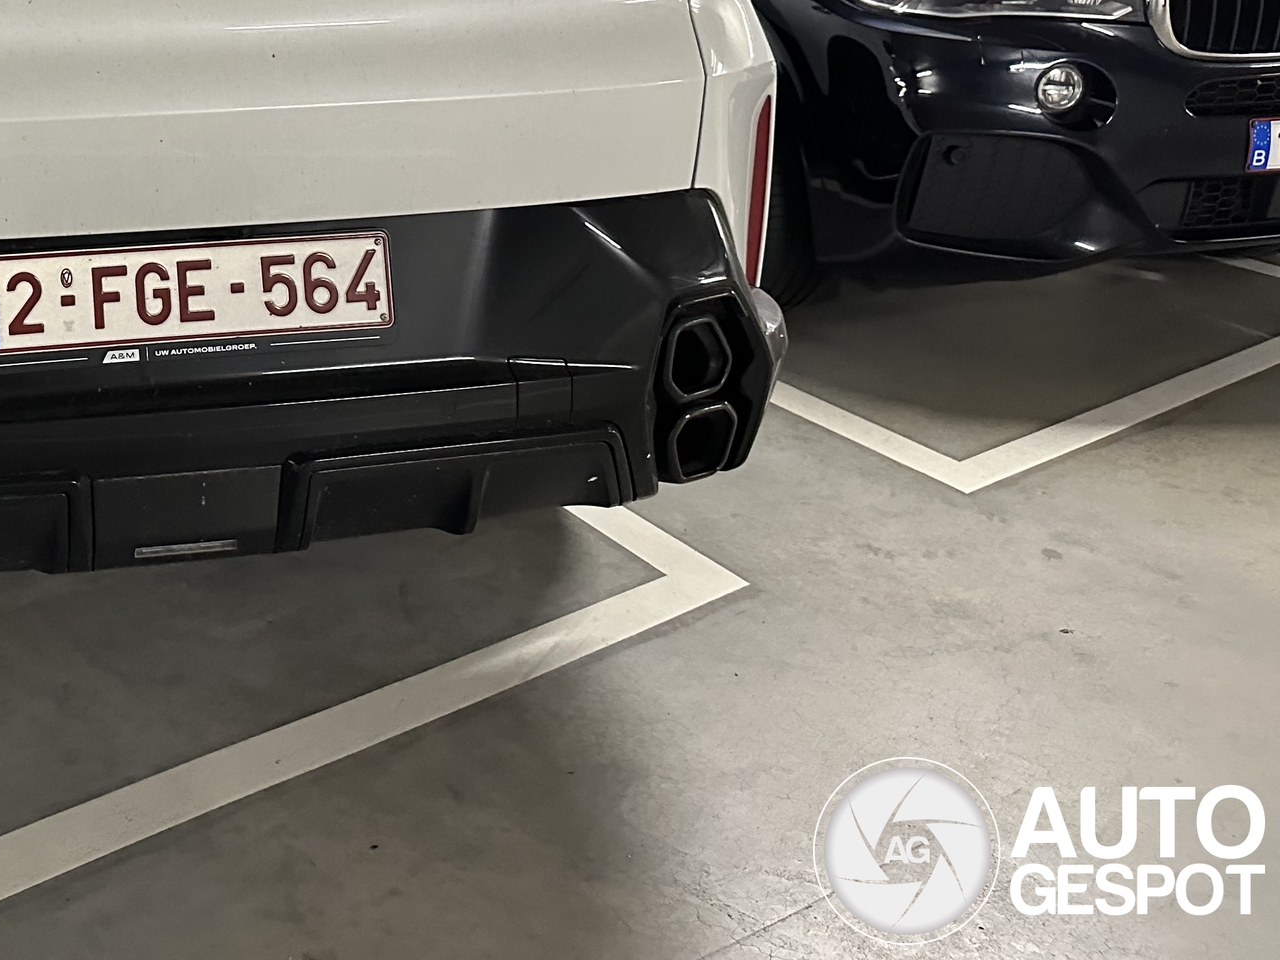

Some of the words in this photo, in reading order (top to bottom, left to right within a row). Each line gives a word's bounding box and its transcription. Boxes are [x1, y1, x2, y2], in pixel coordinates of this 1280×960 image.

[1252, 149, 1266, 166] B
[110, 351, 135, 360] A&M
[154, 349, 169, 357] UW
[170, 343, 257, 355] AUTOMOBIELGROEP.
